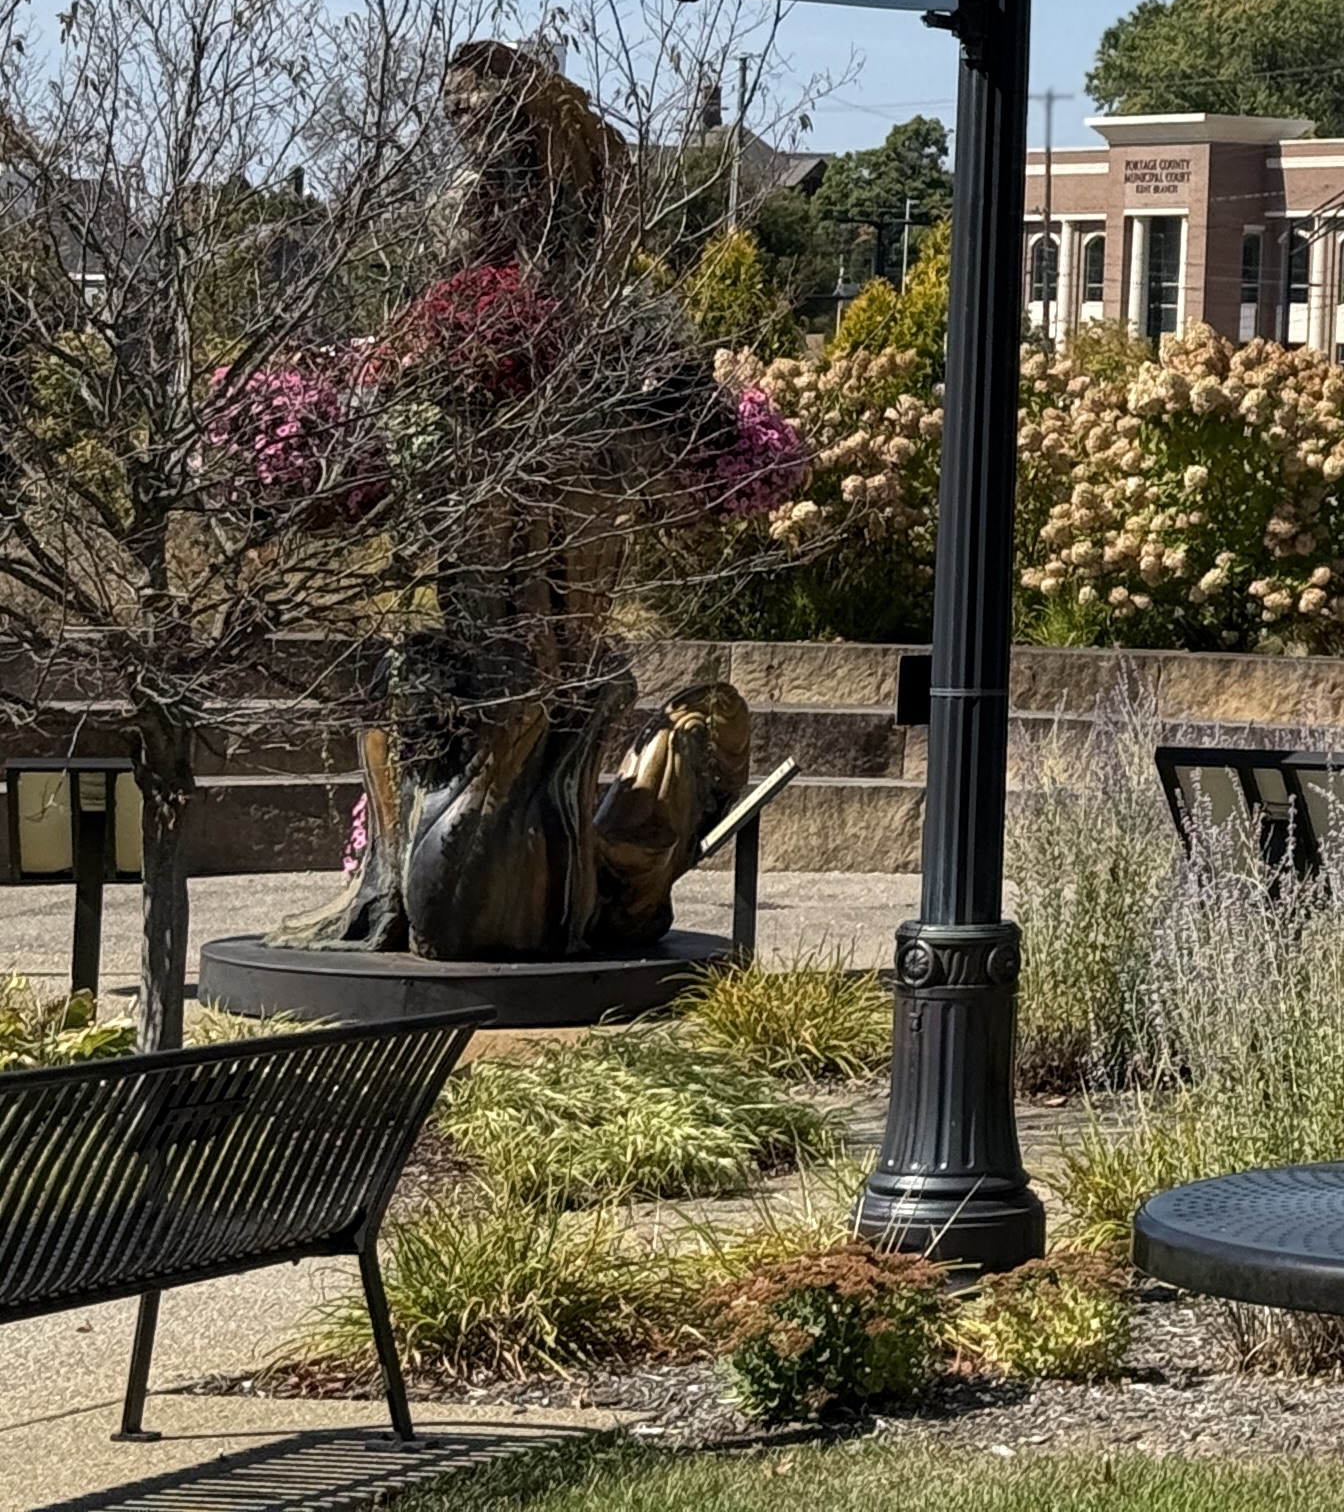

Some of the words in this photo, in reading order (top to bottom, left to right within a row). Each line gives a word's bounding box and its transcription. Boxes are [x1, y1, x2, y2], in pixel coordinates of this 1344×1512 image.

[1125, 159, 1157, 171] PORTAGE
[1159, 159, 1191, 170] COUNTY
[1124, 172, 1164, 184] MUNICIPAL
[1165, 171, 1192, 183] COURT
